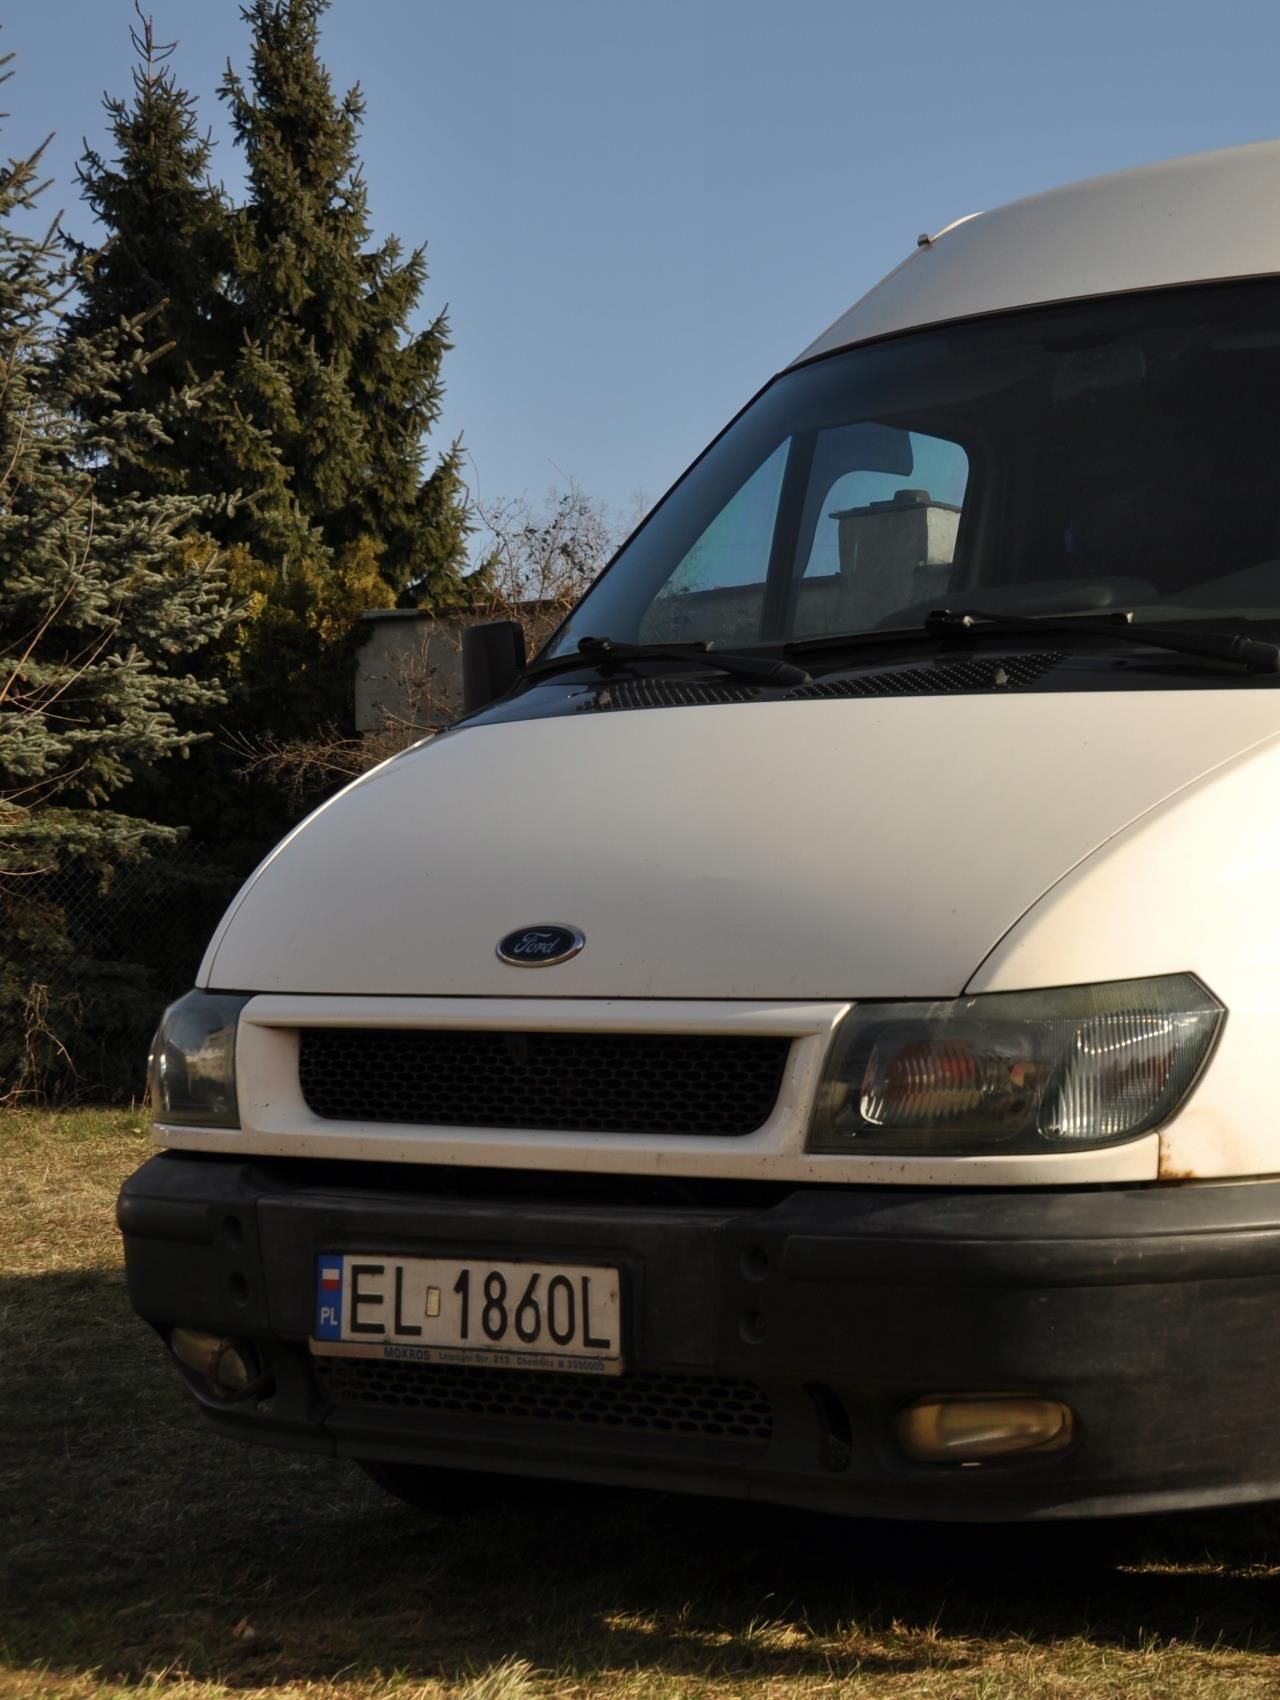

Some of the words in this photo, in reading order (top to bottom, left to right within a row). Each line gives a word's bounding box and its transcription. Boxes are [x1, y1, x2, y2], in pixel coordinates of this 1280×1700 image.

[513, 931, 561, 953] Ford
[320, 1307, 338, 1326] PL
[350, 1264, 422, 1336] EL
[453, 1269, 611, 1349] 1860L
[383, 1346, 430, 1360] MOKROS
